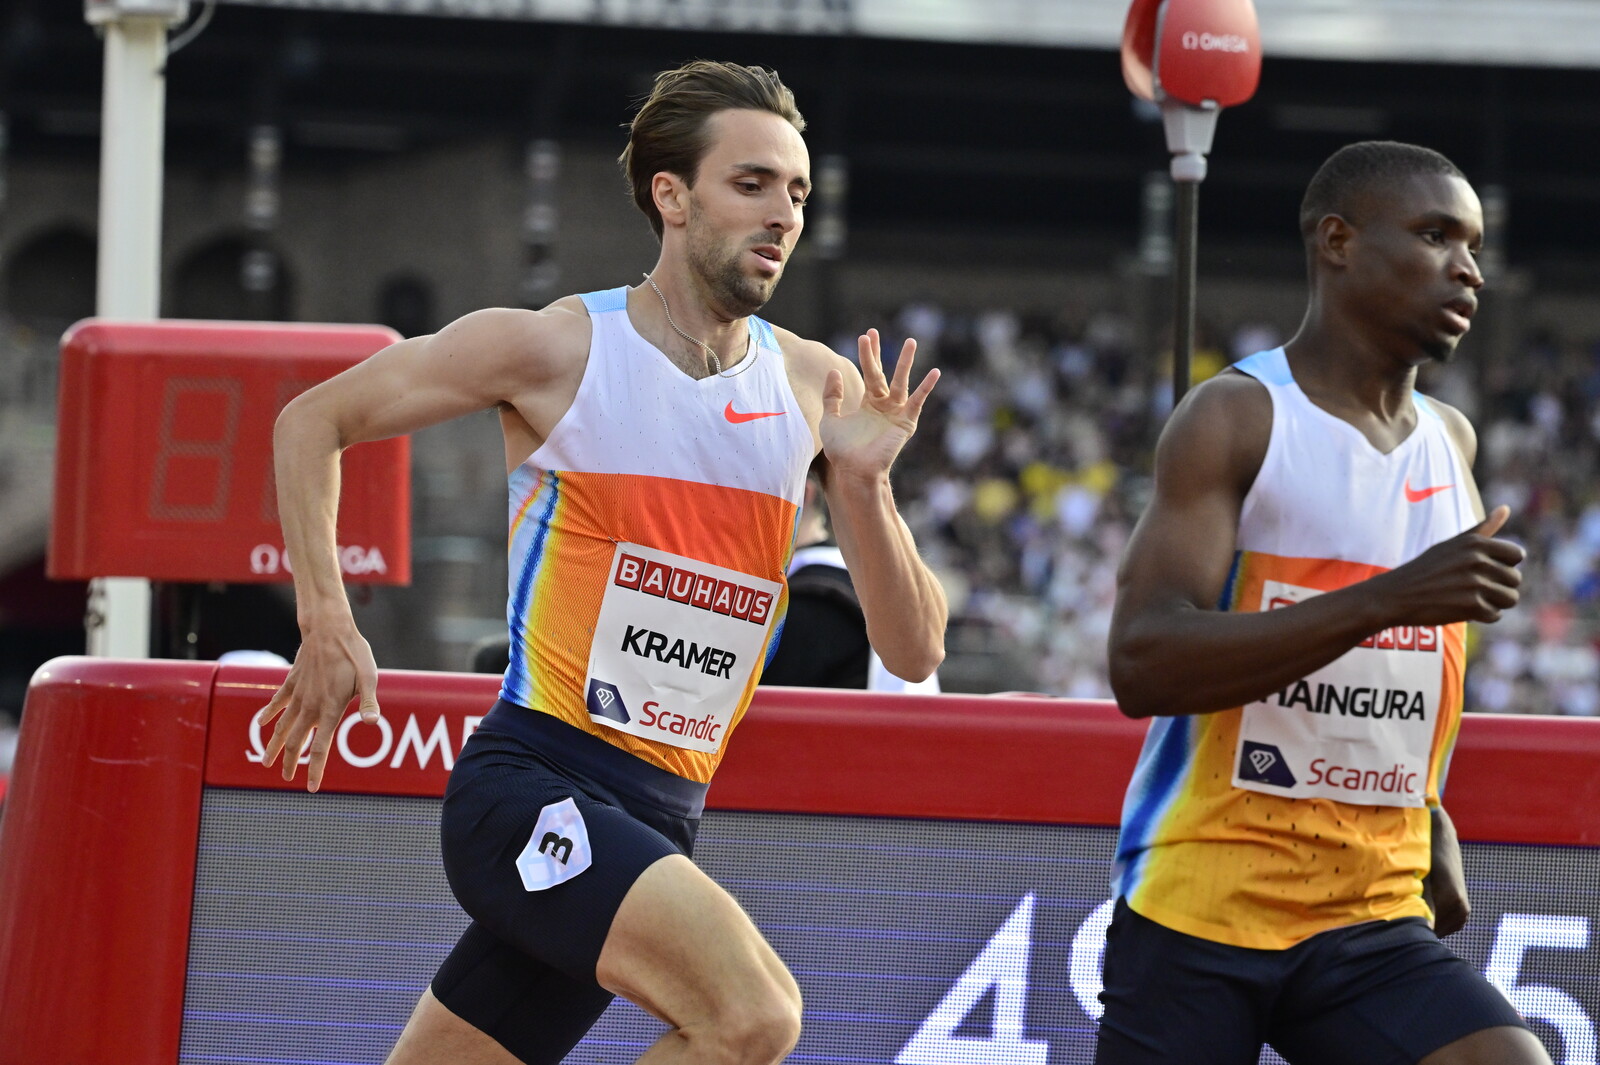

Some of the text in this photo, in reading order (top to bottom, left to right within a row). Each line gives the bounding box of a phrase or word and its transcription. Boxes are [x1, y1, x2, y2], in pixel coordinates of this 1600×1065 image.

[617, 556, 771, 621] BAUHAUS
[621, 625, 737, 680] KRAMER
[638, 700, 722, 743] Scandic
[1306, 758, 1418, 794] Scandic
[537, 831, 574, 866] 3
